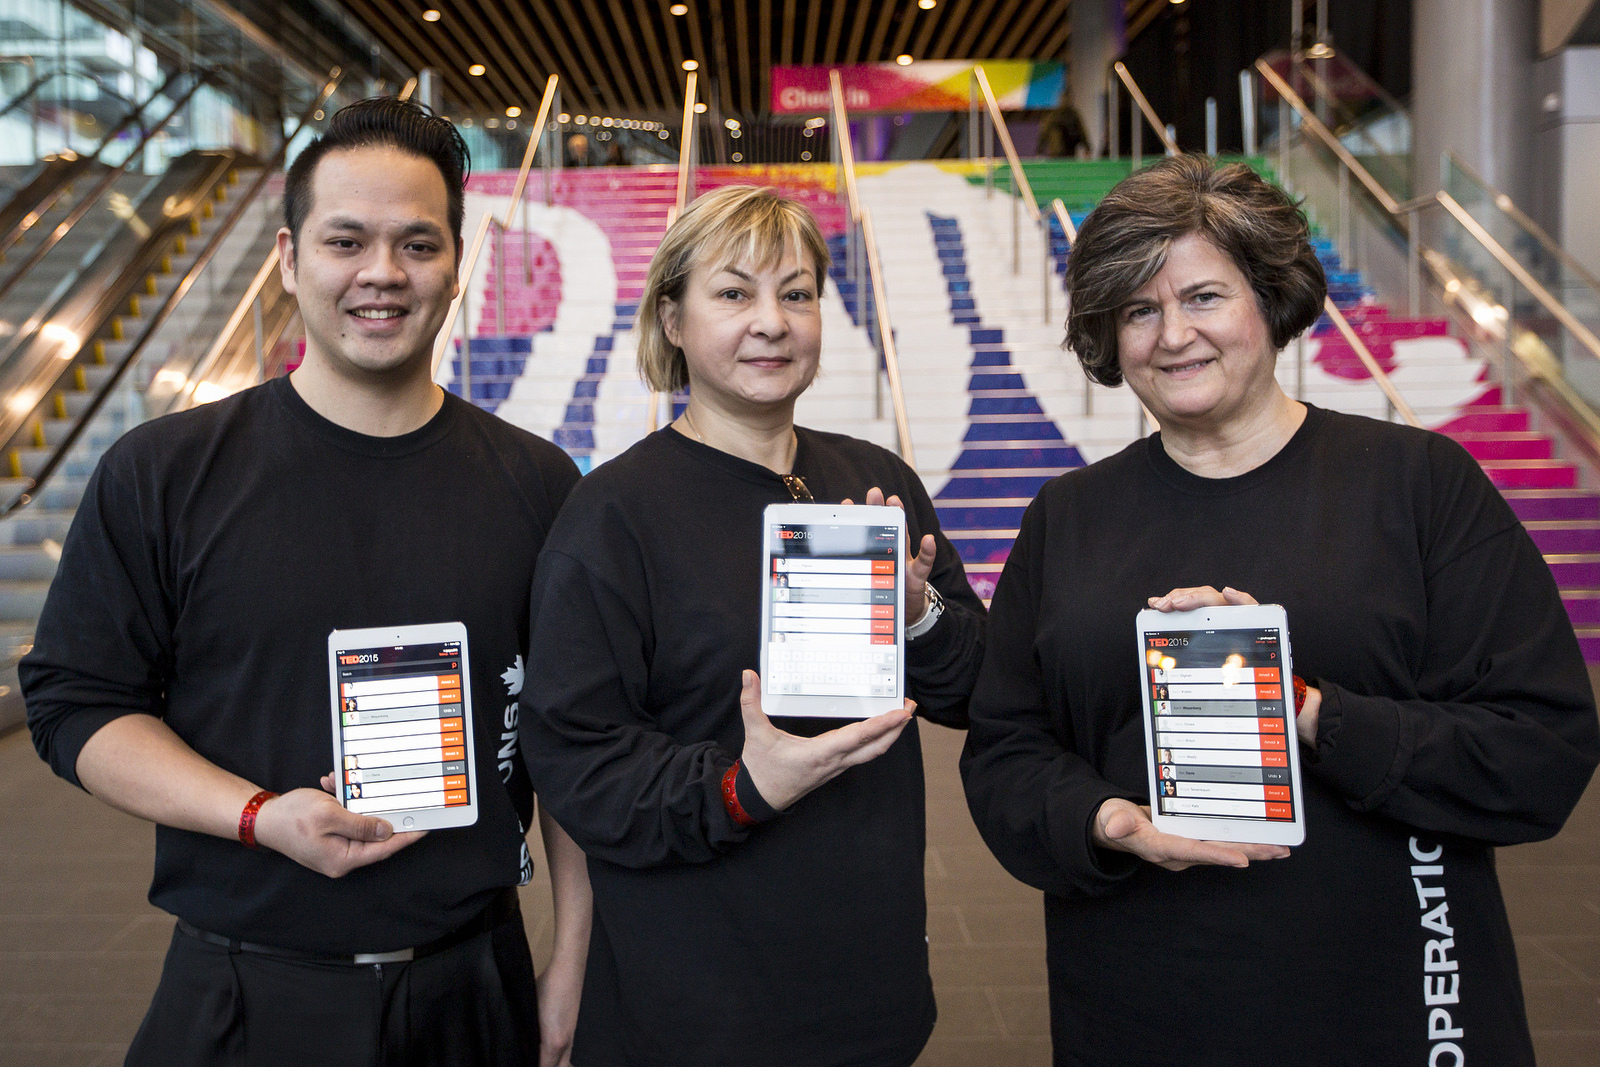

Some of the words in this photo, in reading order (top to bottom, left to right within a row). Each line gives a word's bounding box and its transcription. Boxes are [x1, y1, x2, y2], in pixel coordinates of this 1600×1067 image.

[780, 87, 845, 109] Chec
[774, 530, 813, 540] TED2015
[1148, 637, 1189, 647] TED2015
[339, 653, 379, 665] TED2015
